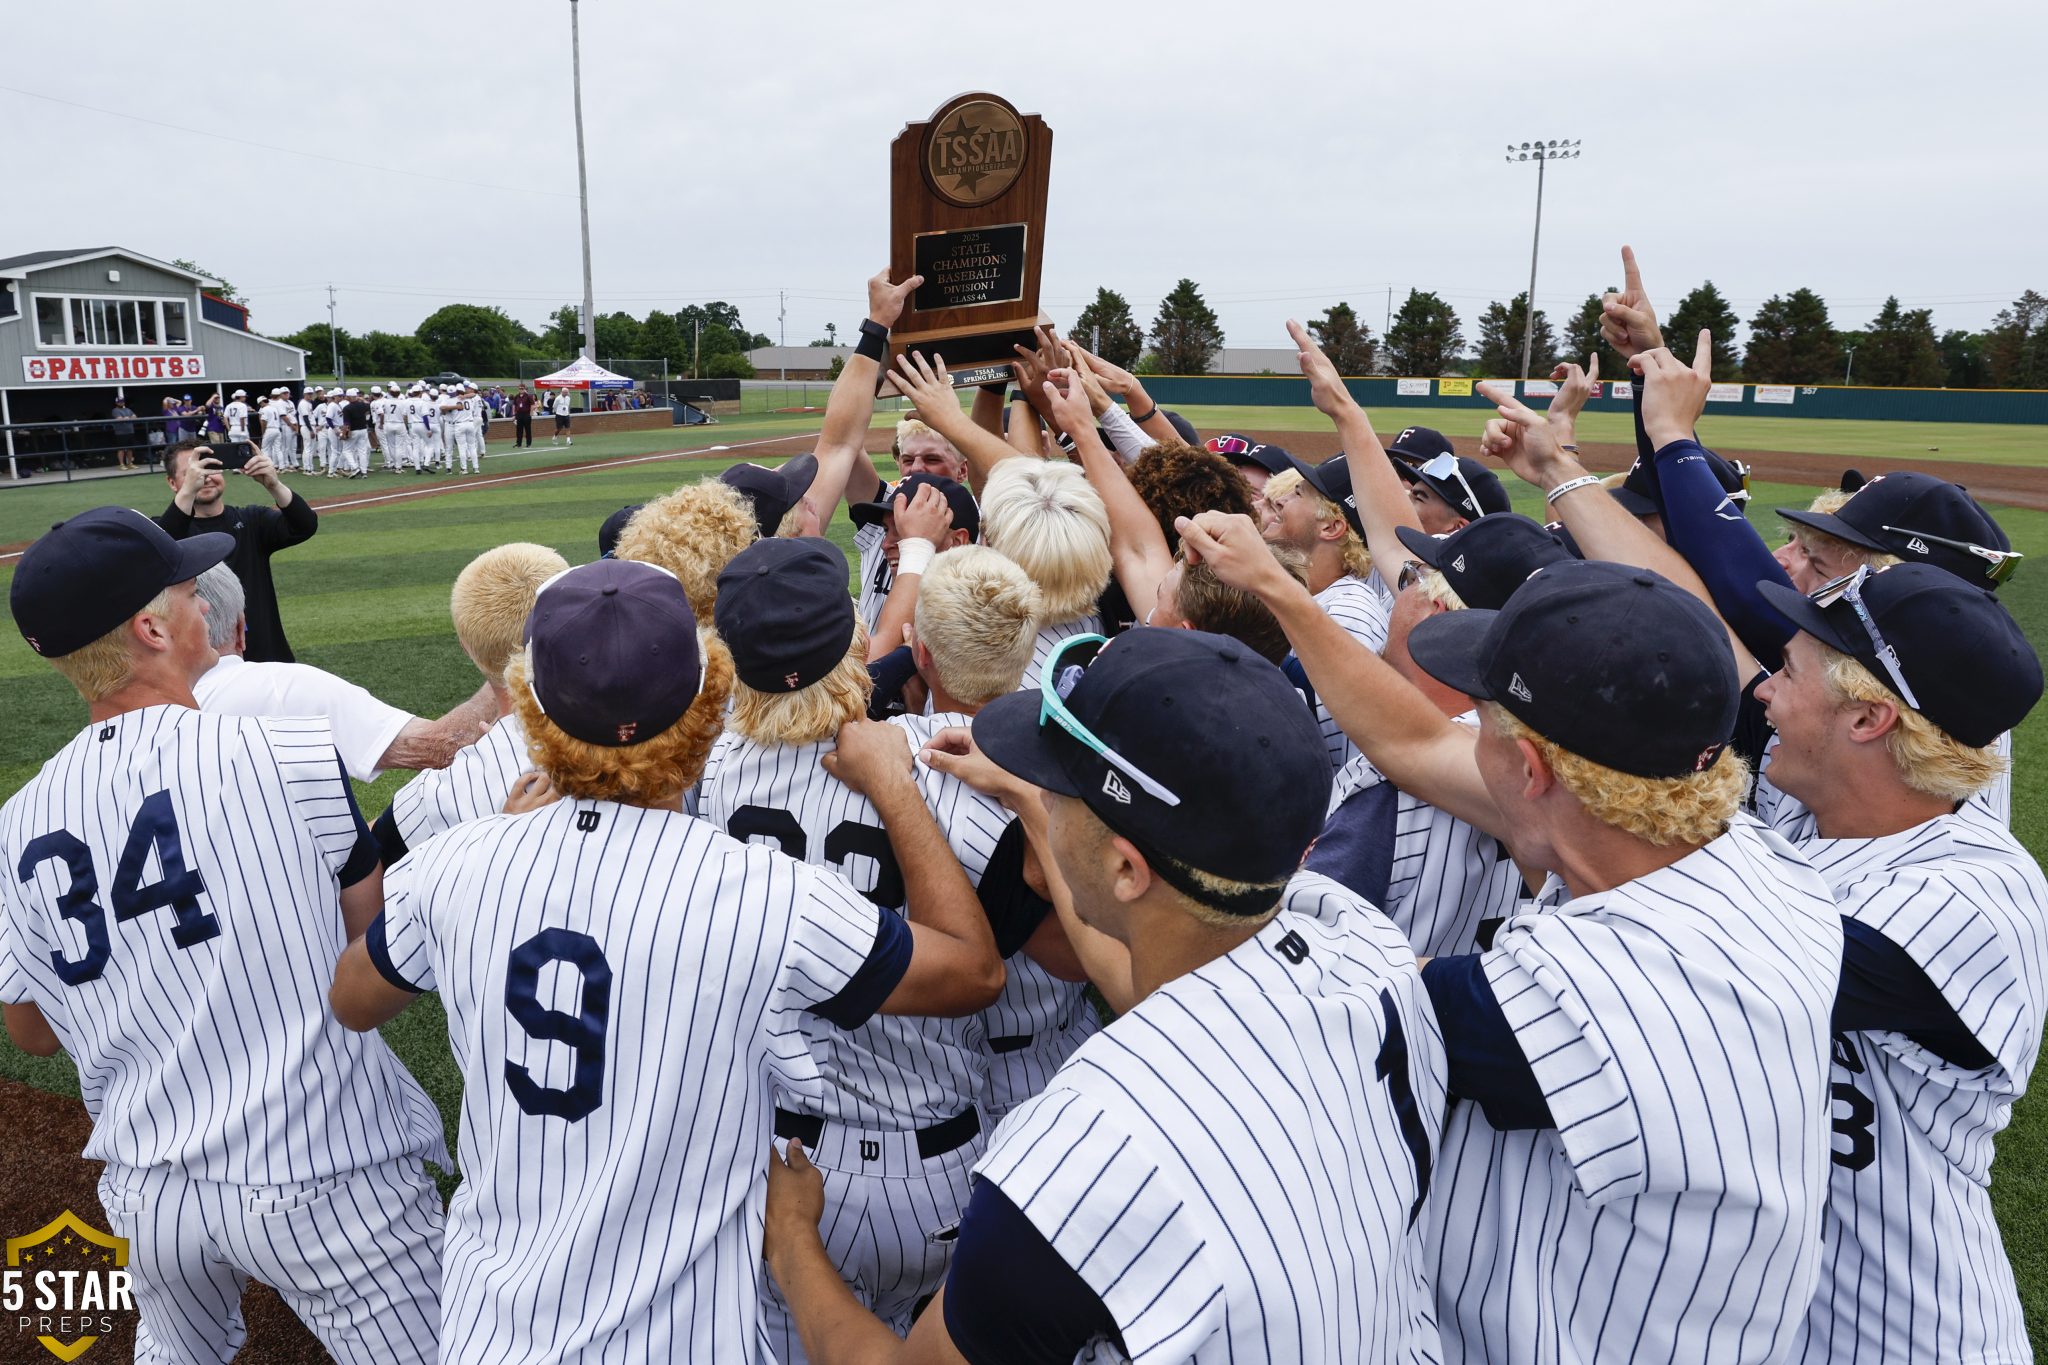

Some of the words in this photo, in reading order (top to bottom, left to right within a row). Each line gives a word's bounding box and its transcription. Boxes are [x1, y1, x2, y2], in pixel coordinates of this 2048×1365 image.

[937, 130, 1017, 168] TSSAA
[948, 163, 1006, 175] CHAMPIONSHIPS
[963, 233, 980, 242] 2025
[952, 243, 991, 257] STATE
[933, 254, 1007, 271] CHAMPIONS
[938, 268, 1001, 284] BASEBALL
[944, 283, 988, 295] DIVISION
[950, 294, 975, 304] CLASS
[977, 293, 987, 301] 4A
[47, 357, 184, 380] PATRIOTS
[974, 368, 995, 376] TSSAA
[963, 374, 987, 383] SPRING
[988, 372, 1008, 380] FLING
[1802, 387, 1818, 395] 357
[229, 407, 238, 418] 17
[390, 404, 396, 414] 7
[410, 404, 416, 414] 9
[429, 408, 436, 418] 3
[1055, 715, 1074, 732] 100%
[17, 788, 222, 987] 34
[505, 926, 614, 1124] 9
